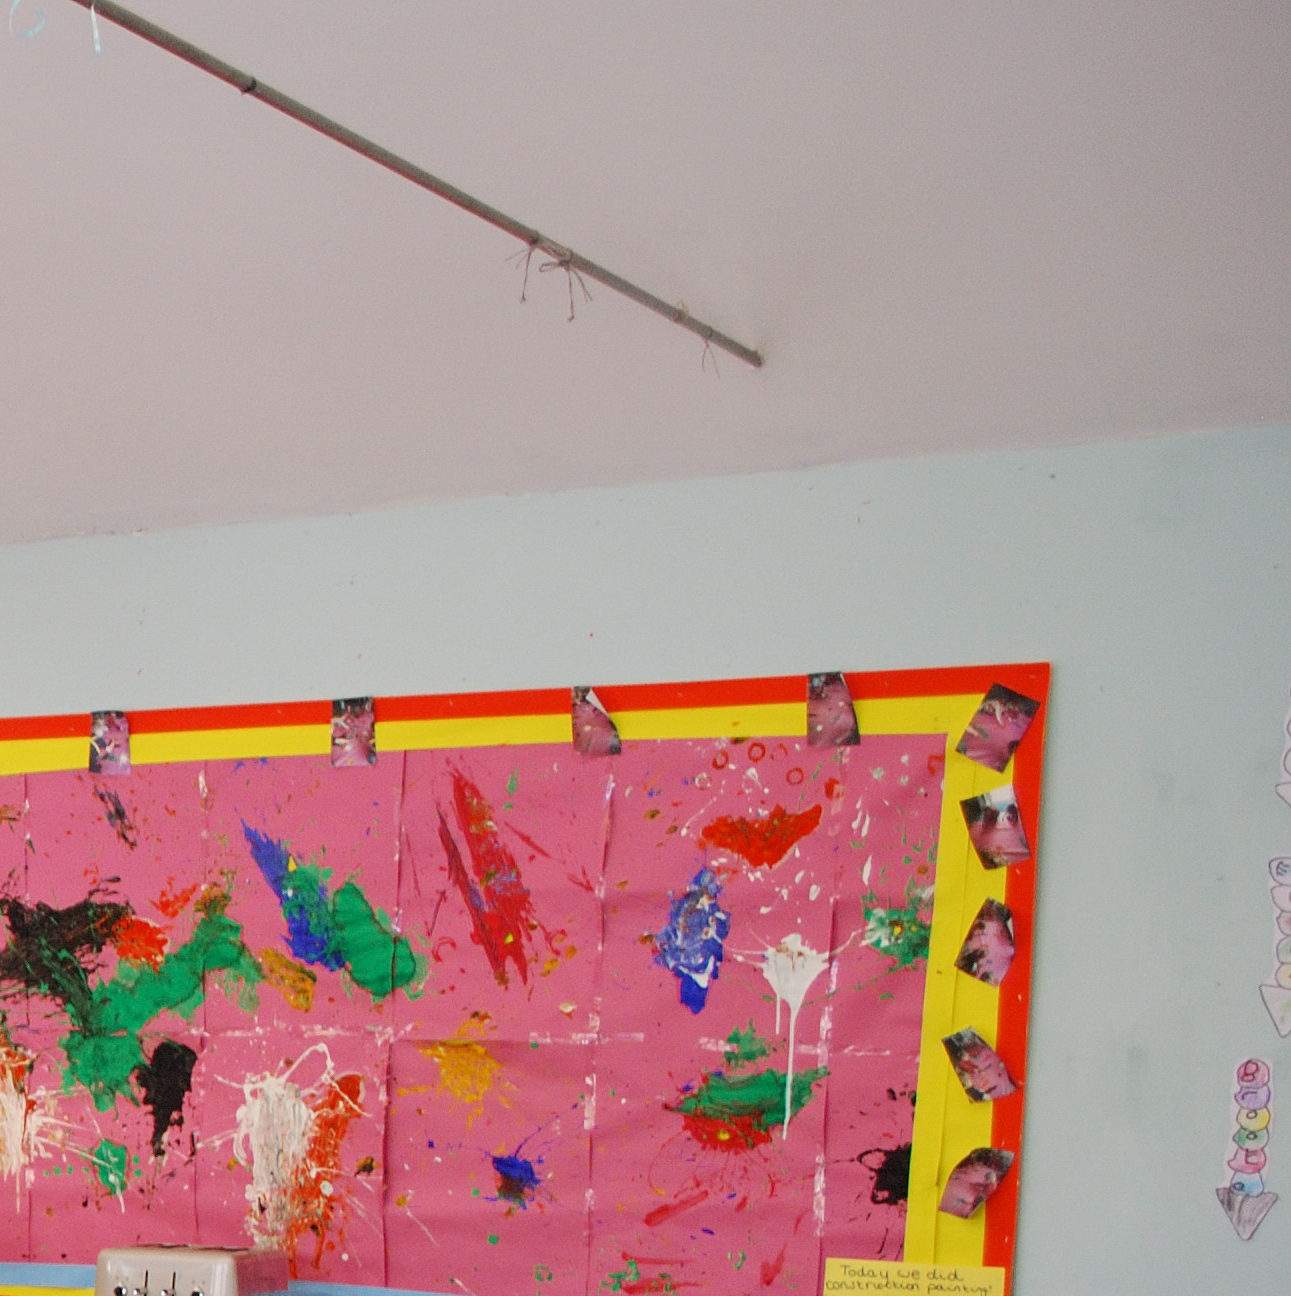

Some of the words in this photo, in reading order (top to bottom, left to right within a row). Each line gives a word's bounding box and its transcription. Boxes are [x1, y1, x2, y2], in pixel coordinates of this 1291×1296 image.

[840, 1264, 889, 1283] Today
[897, 1270, 919, 1280] we
[926, 1267, 964, 1282] did
[825, 1280, 919, 1291] construction
